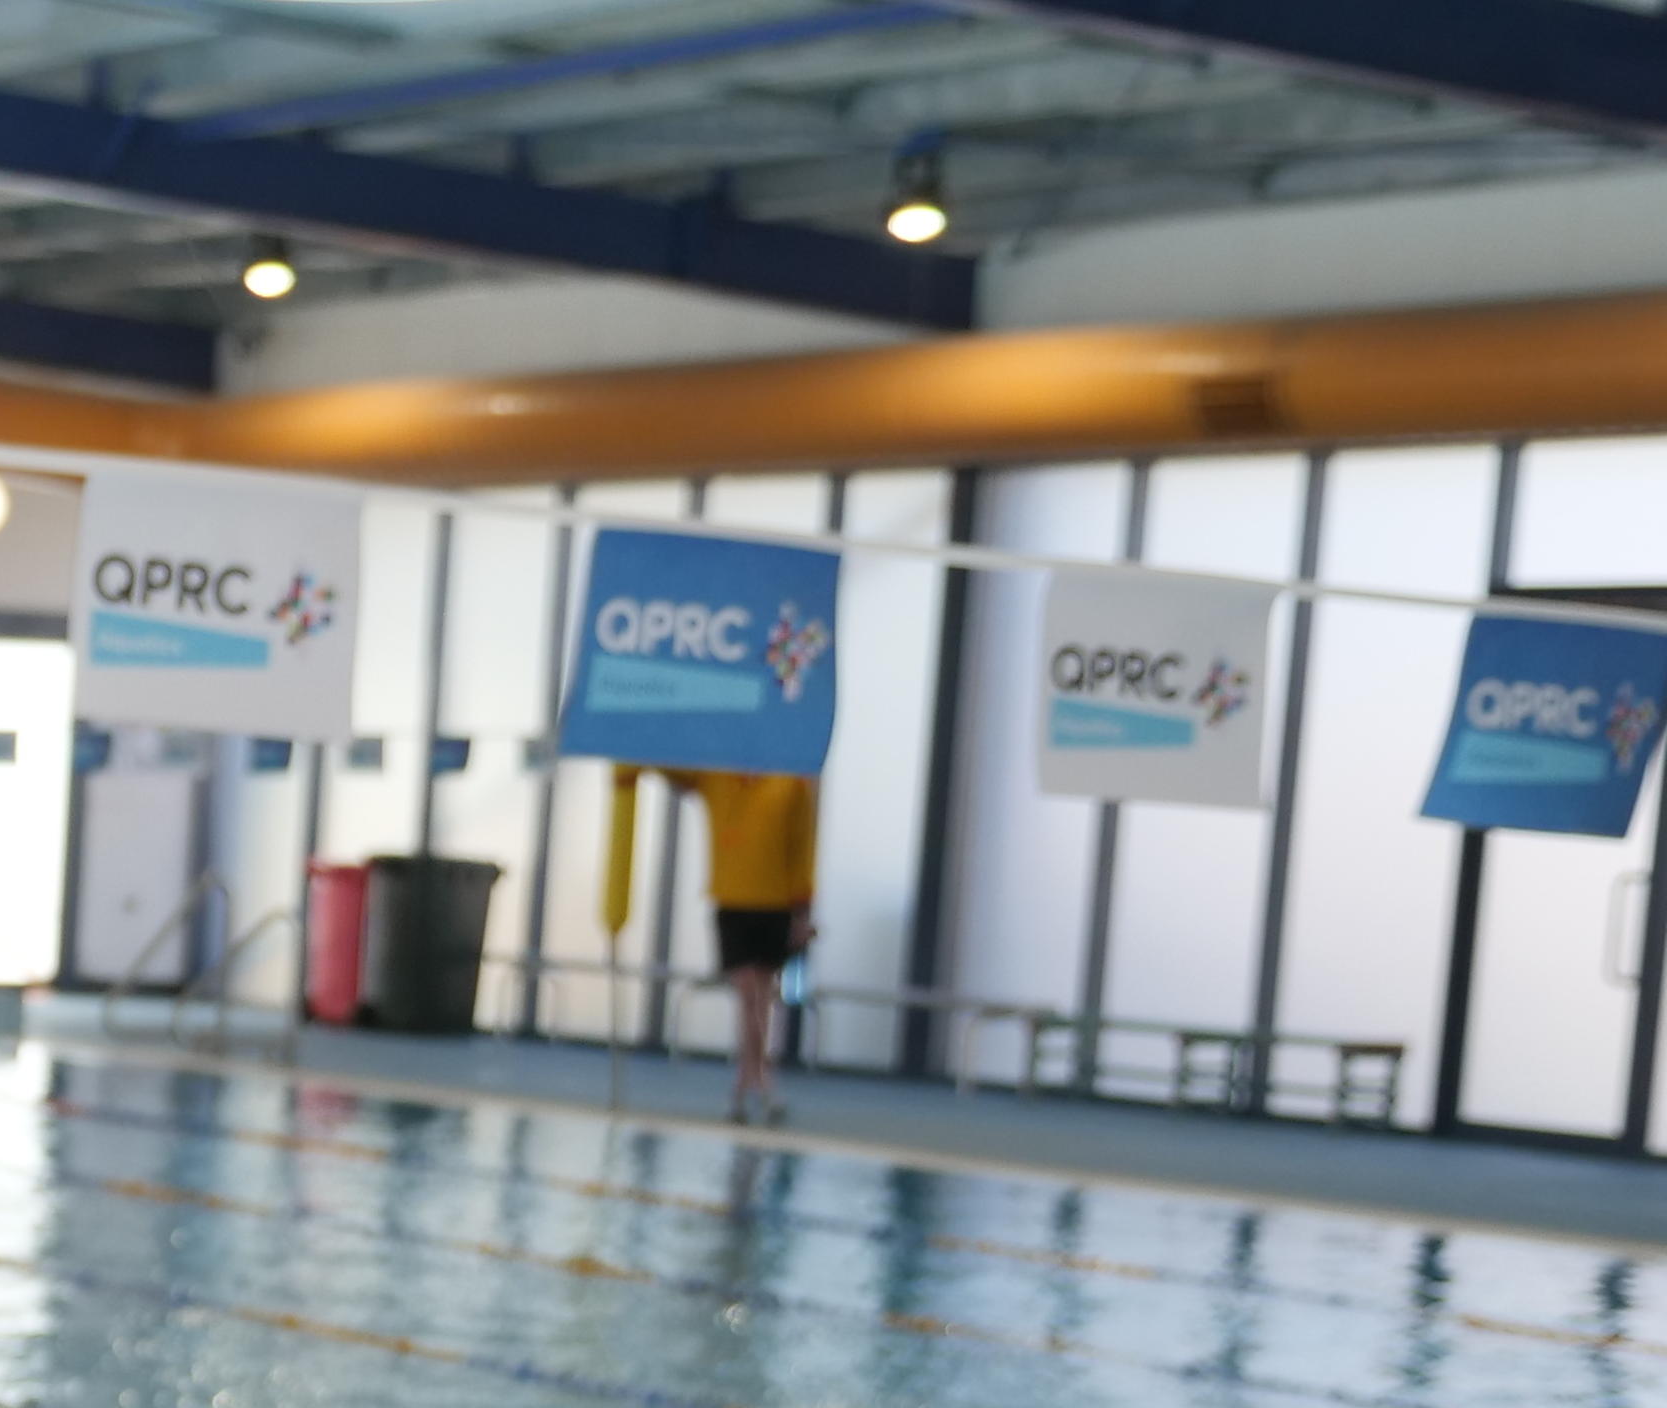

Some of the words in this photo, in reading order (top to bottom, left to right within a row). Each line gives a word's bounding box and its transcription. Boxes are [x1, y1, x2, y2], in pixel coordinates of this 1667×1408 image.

[93, 554, 252, 616] QPRC
[595, 598, 750, 662] QPRC
[1052, 645, 1181, 700] QPRC
[1466, 678, 1599, 738] QPRC
